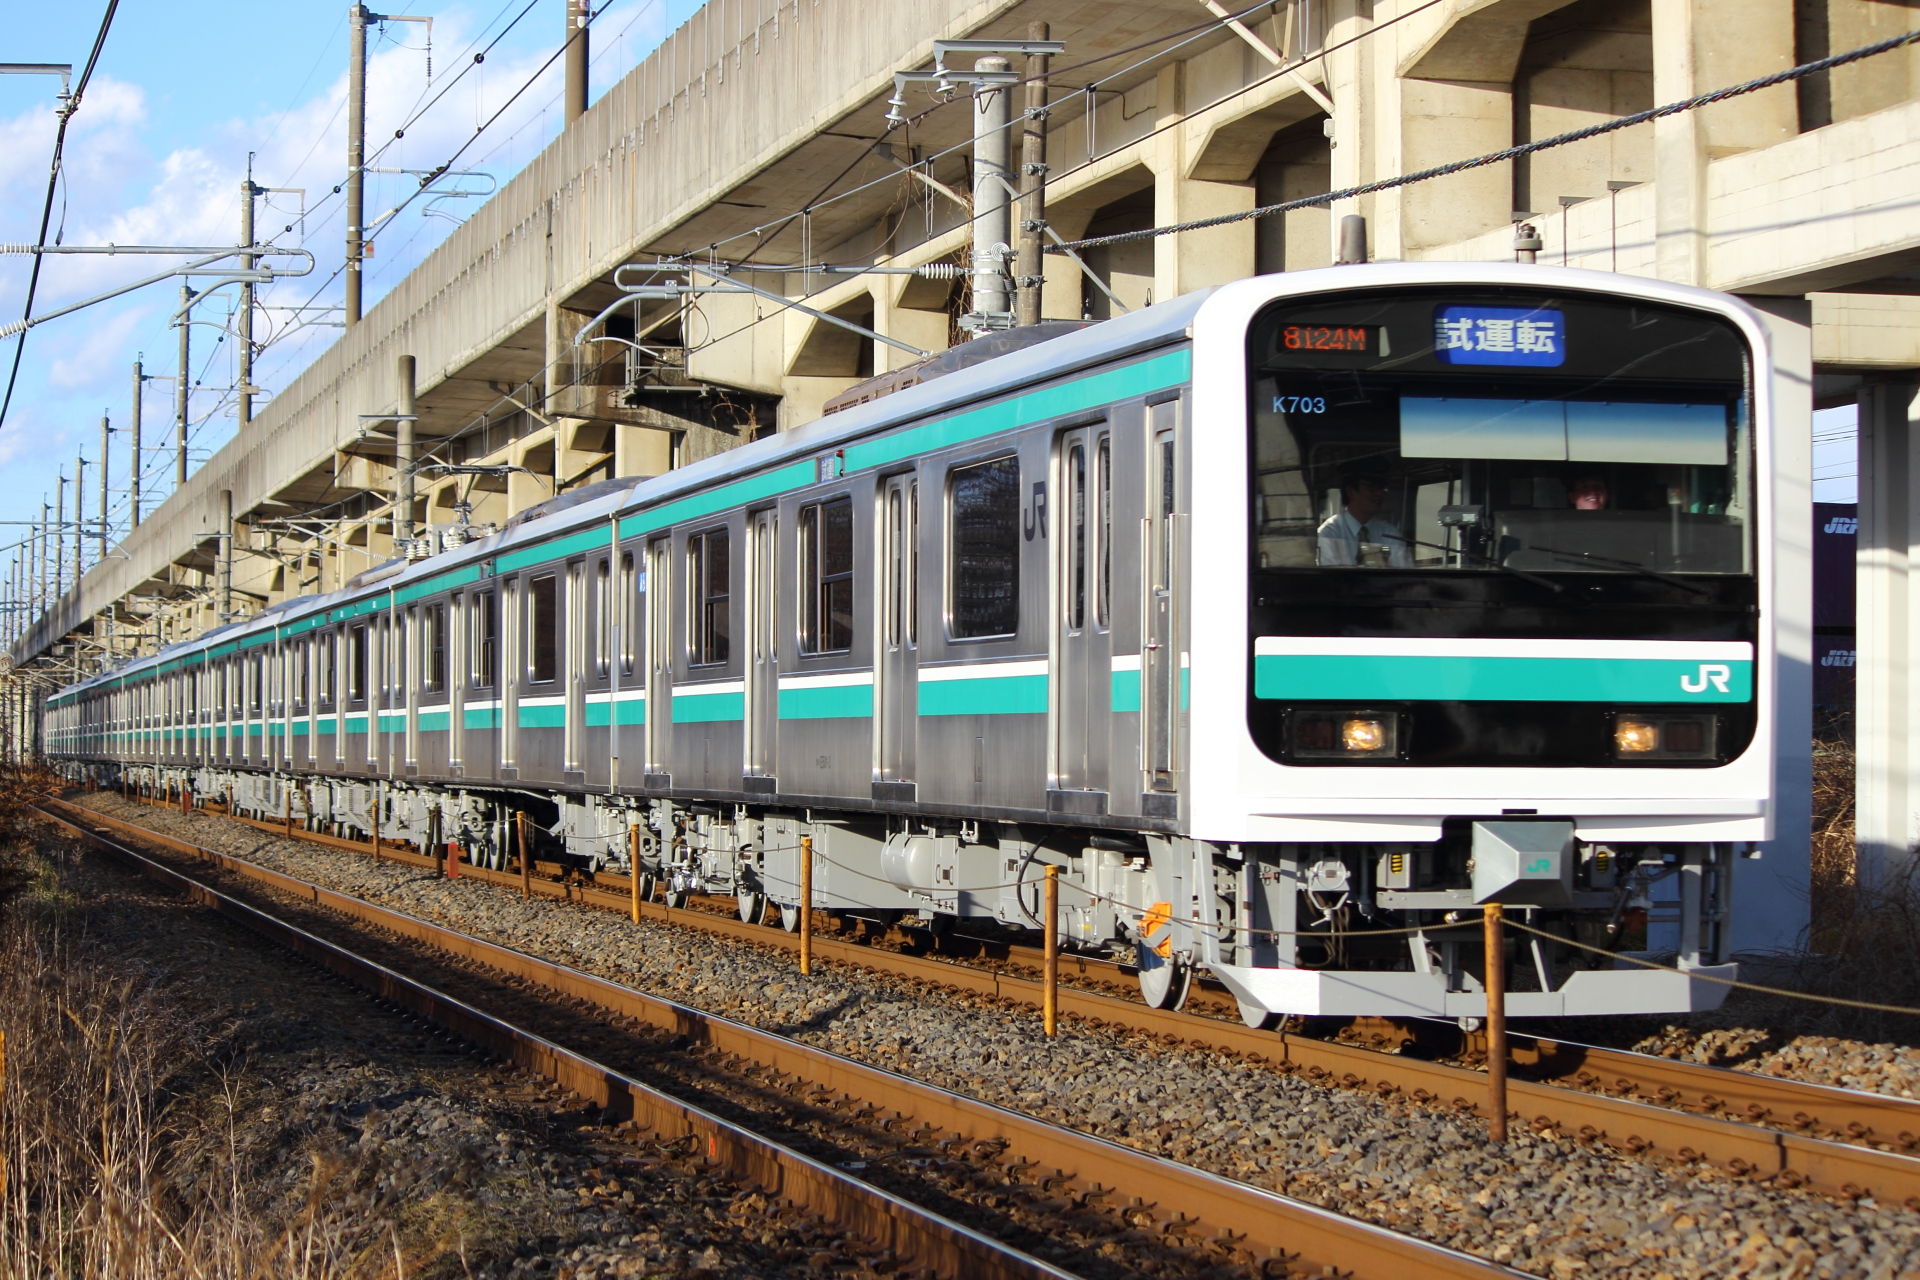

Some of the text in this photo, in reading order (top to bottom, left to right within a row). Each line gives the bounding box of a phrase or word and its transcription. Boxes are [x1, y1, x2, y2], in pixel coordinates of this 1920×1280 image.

[1283, 326, 1366, 350] 8124M
[1435, 317, 1555, 353] 試運転
[1272, 396, 1326, 413] K703
[1024, 480, 1046, 541] JR
[1681, 664, 1730, 693] JR
[1527, 859, 1551, 872] JR
